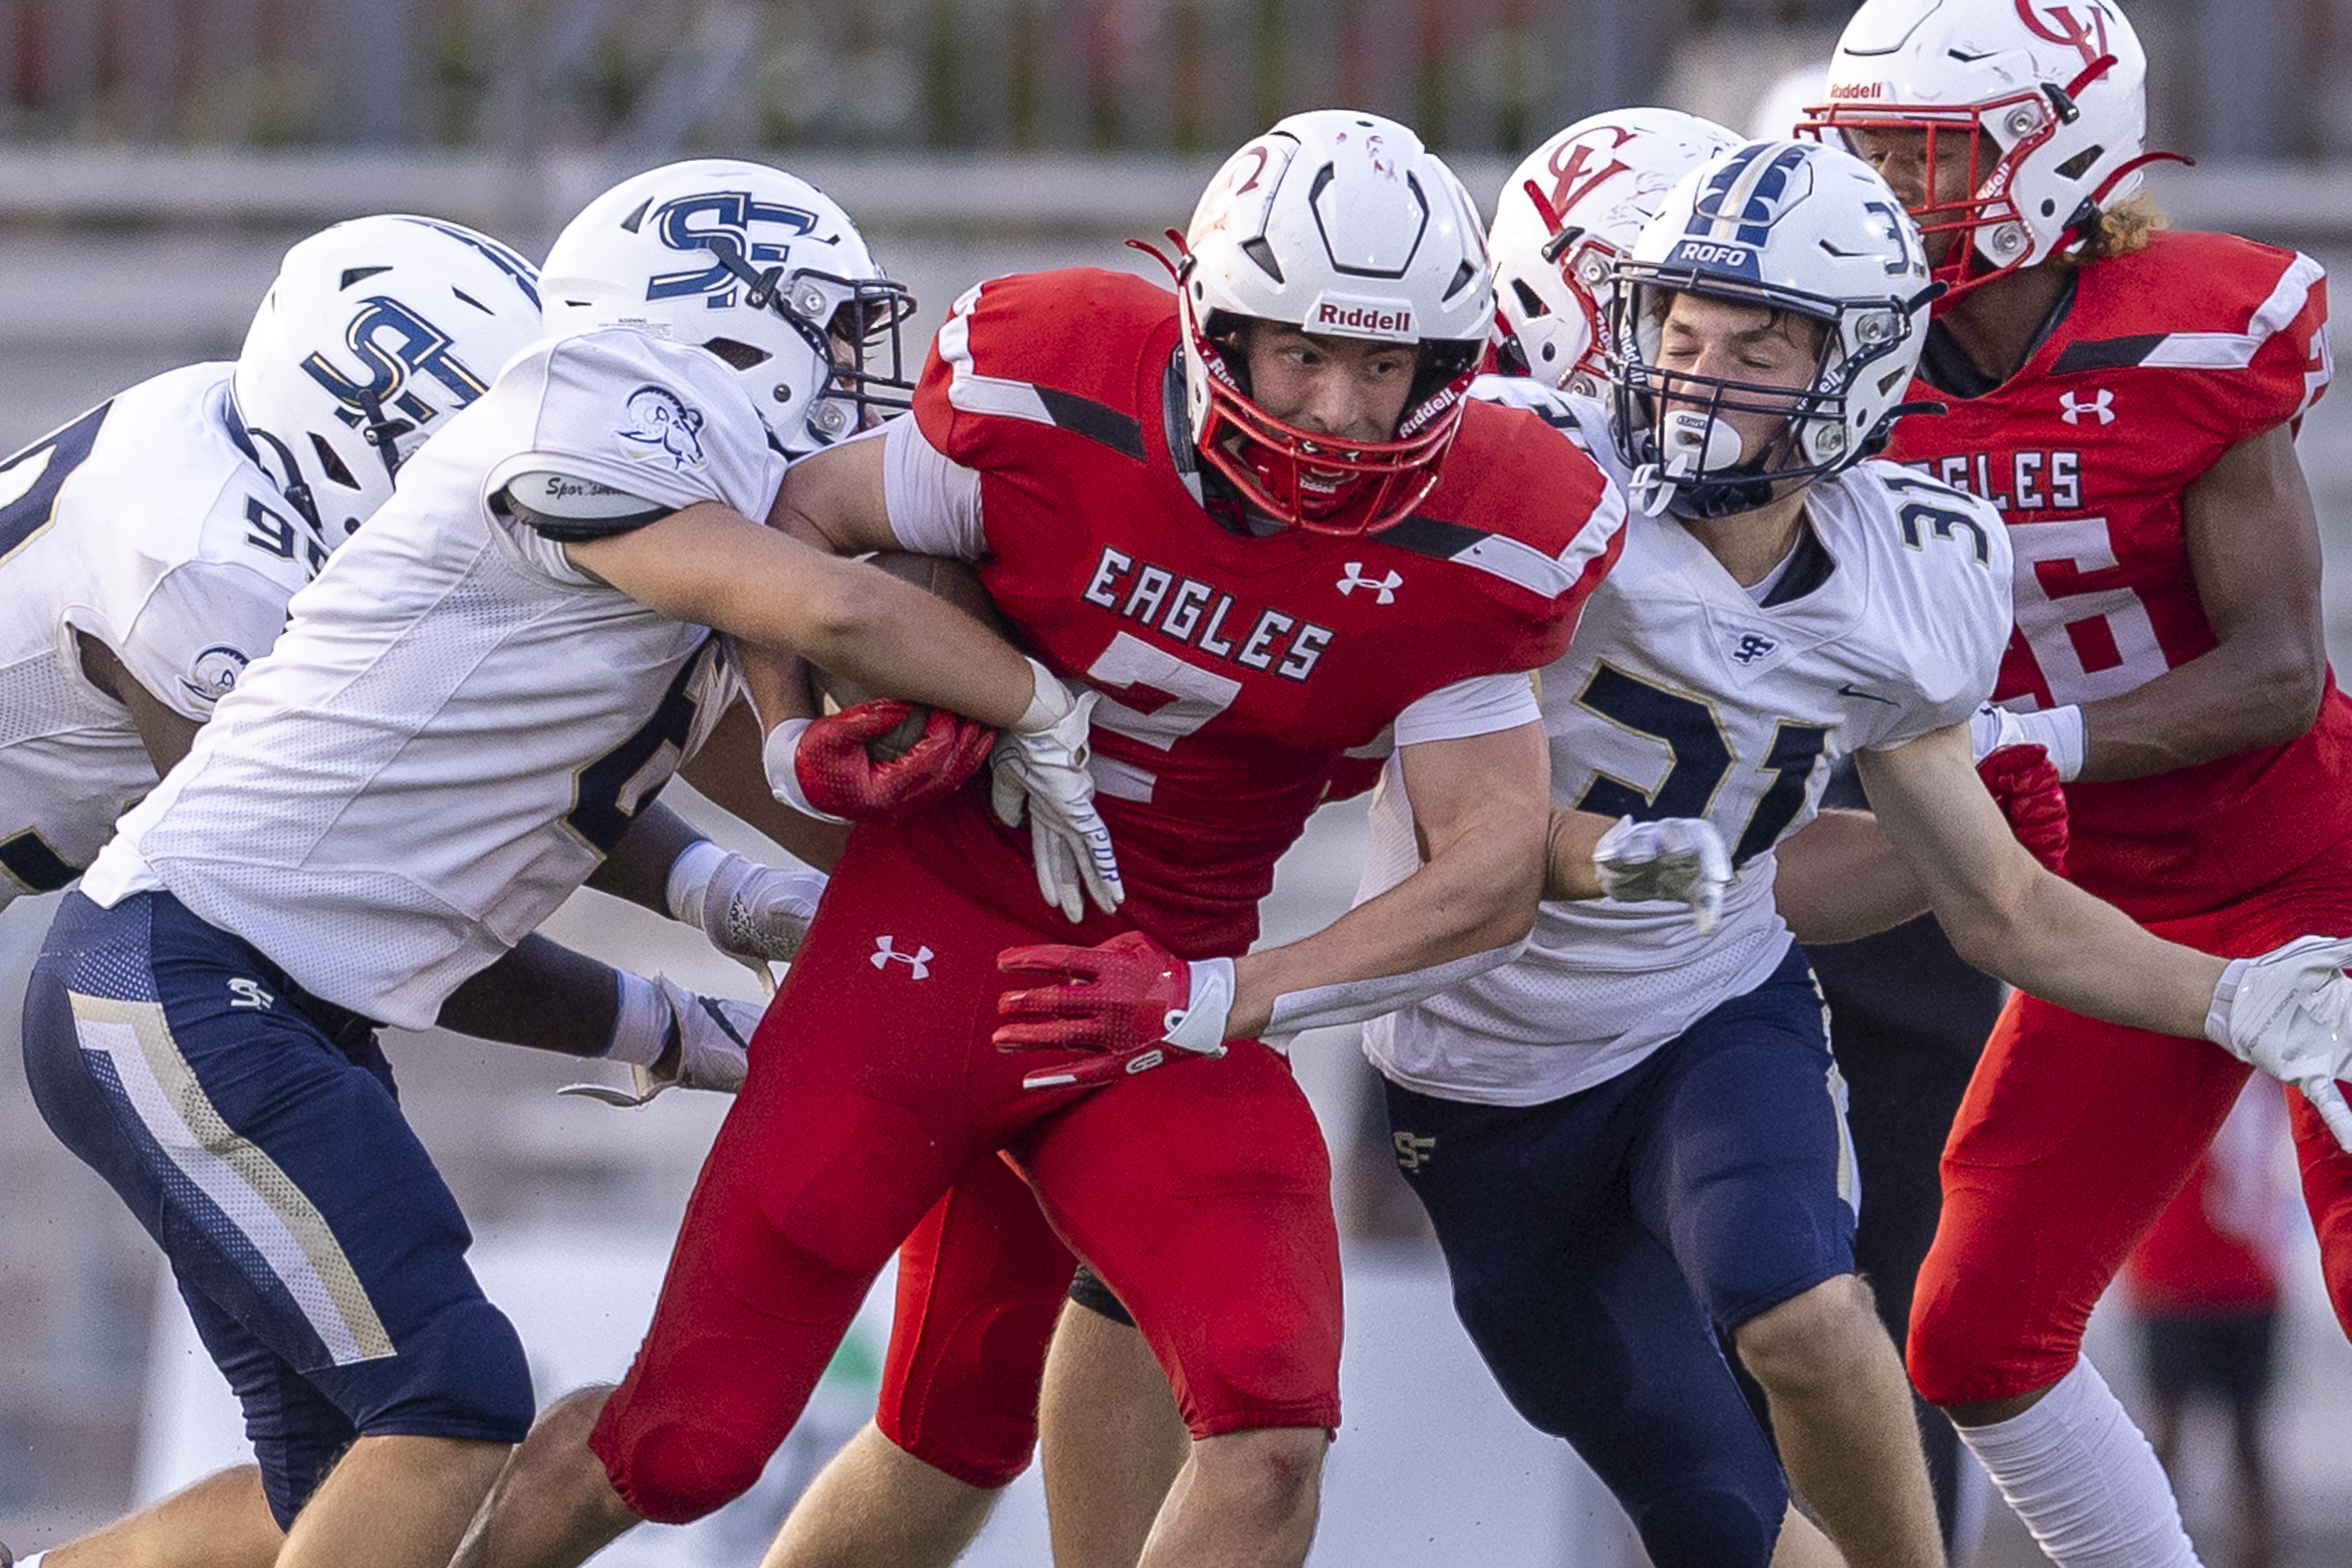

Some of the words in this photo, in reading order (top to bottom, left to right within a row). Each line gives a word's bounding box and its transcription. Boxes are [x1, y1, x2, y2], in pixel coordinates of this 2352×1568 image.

[1680, 242, 1748, 267] ROFO
[1319, 302, 1411, 333] Riddell
[1620, 324, 1647, 383] Riddll
[1398, 386, 1456, 439] Riddell
[1081, 543, 1335, 683] EAGLES
